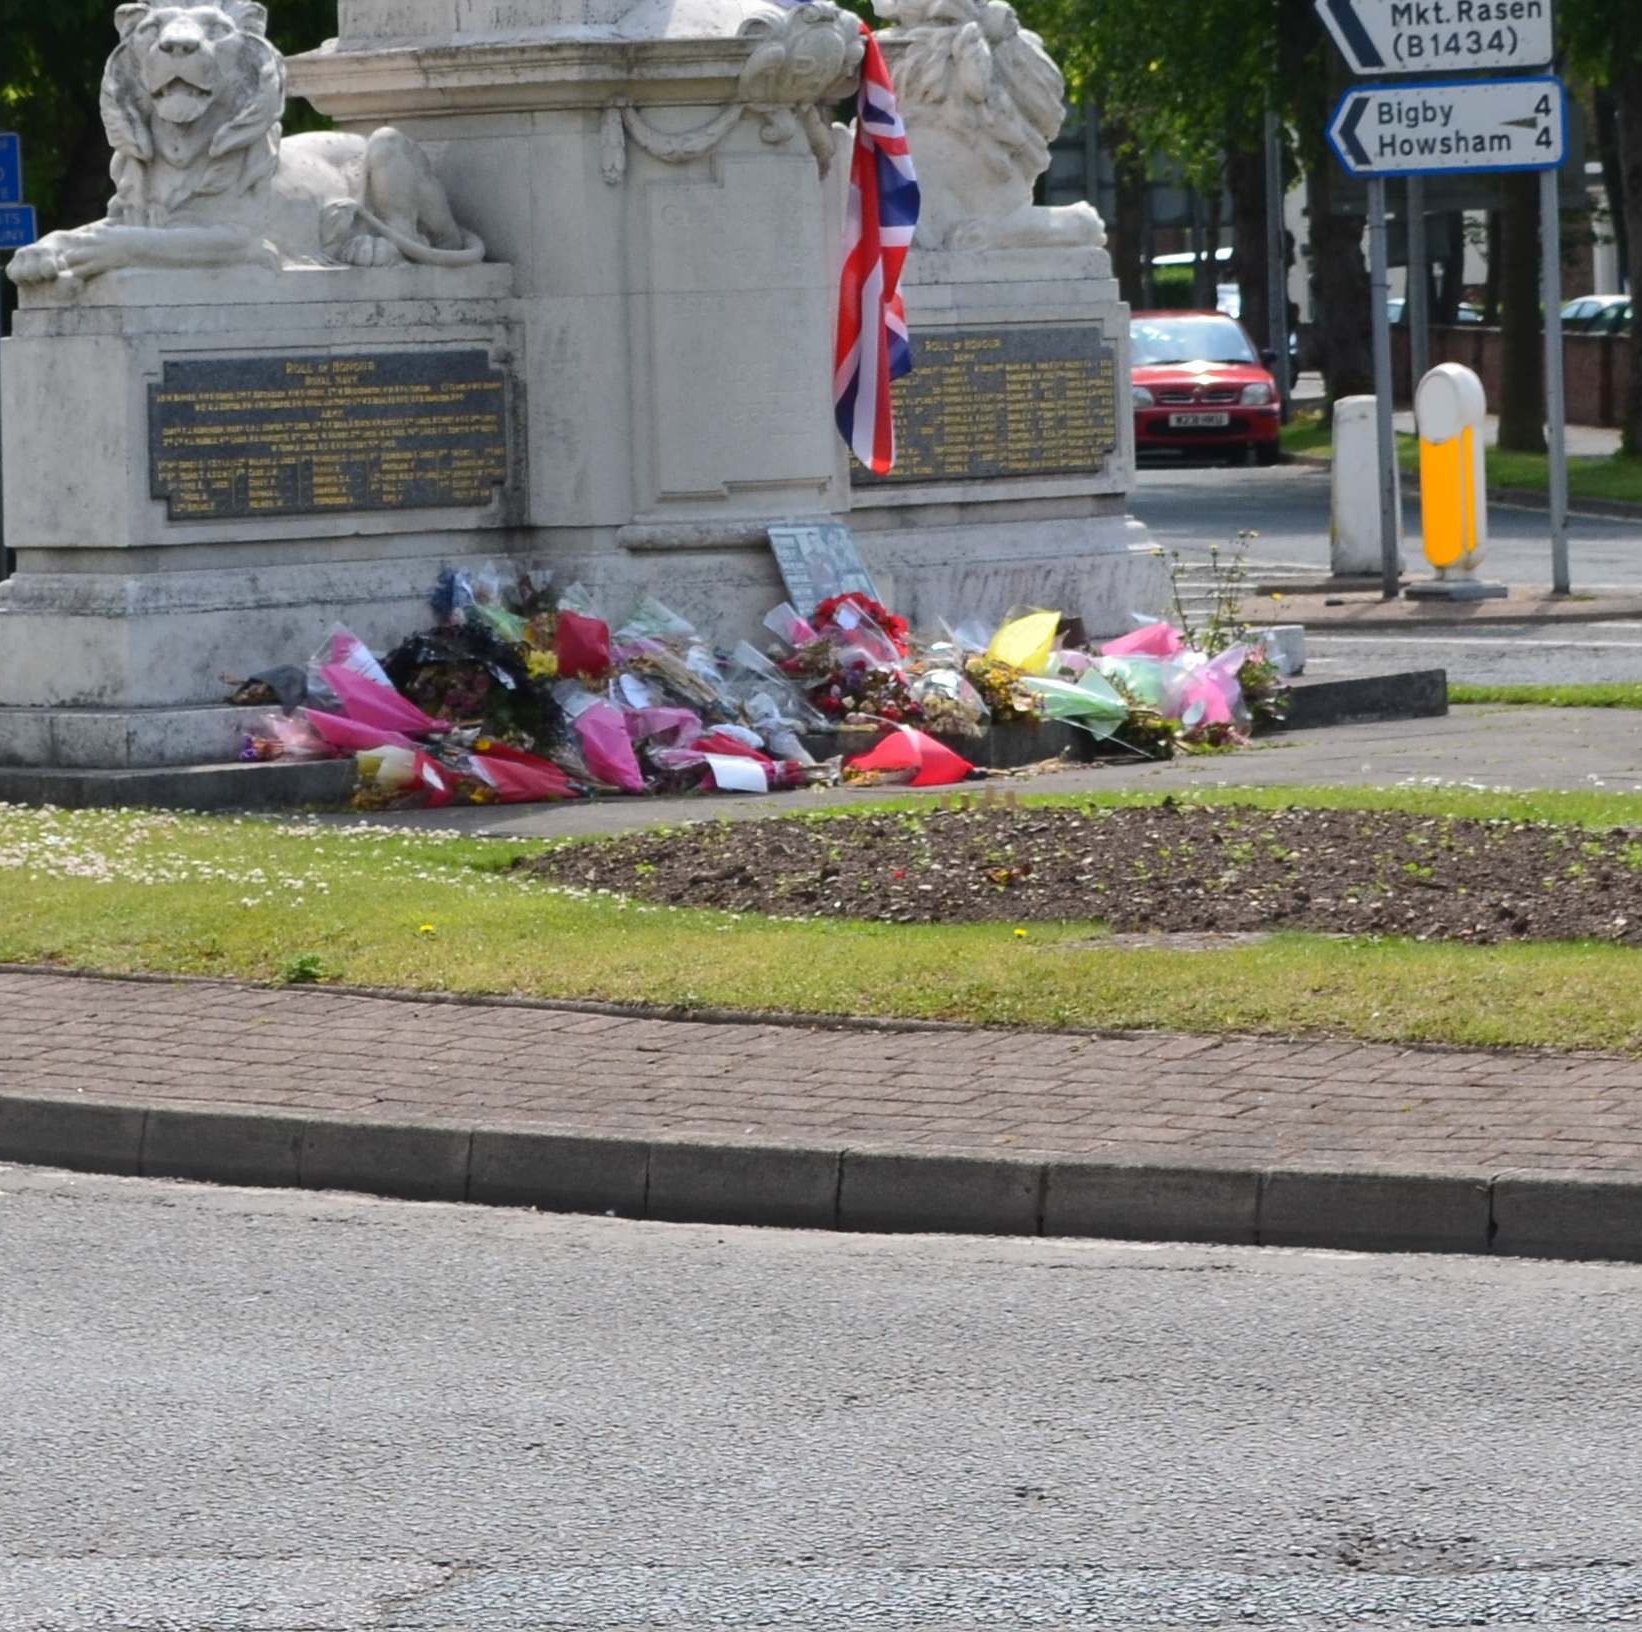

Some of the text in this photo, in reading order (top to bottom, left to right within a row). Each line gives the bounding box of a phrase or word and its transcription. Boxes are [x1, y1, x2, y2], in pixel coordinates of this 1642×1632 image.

[1390, 0, 1542, 27] Mkt. Rasen
[1392, 25, 1518, 62] (B1434)
[1377, 93, 1552, 129] Bigby 4
[1378, 126, 1553, 157] Howsham 4
